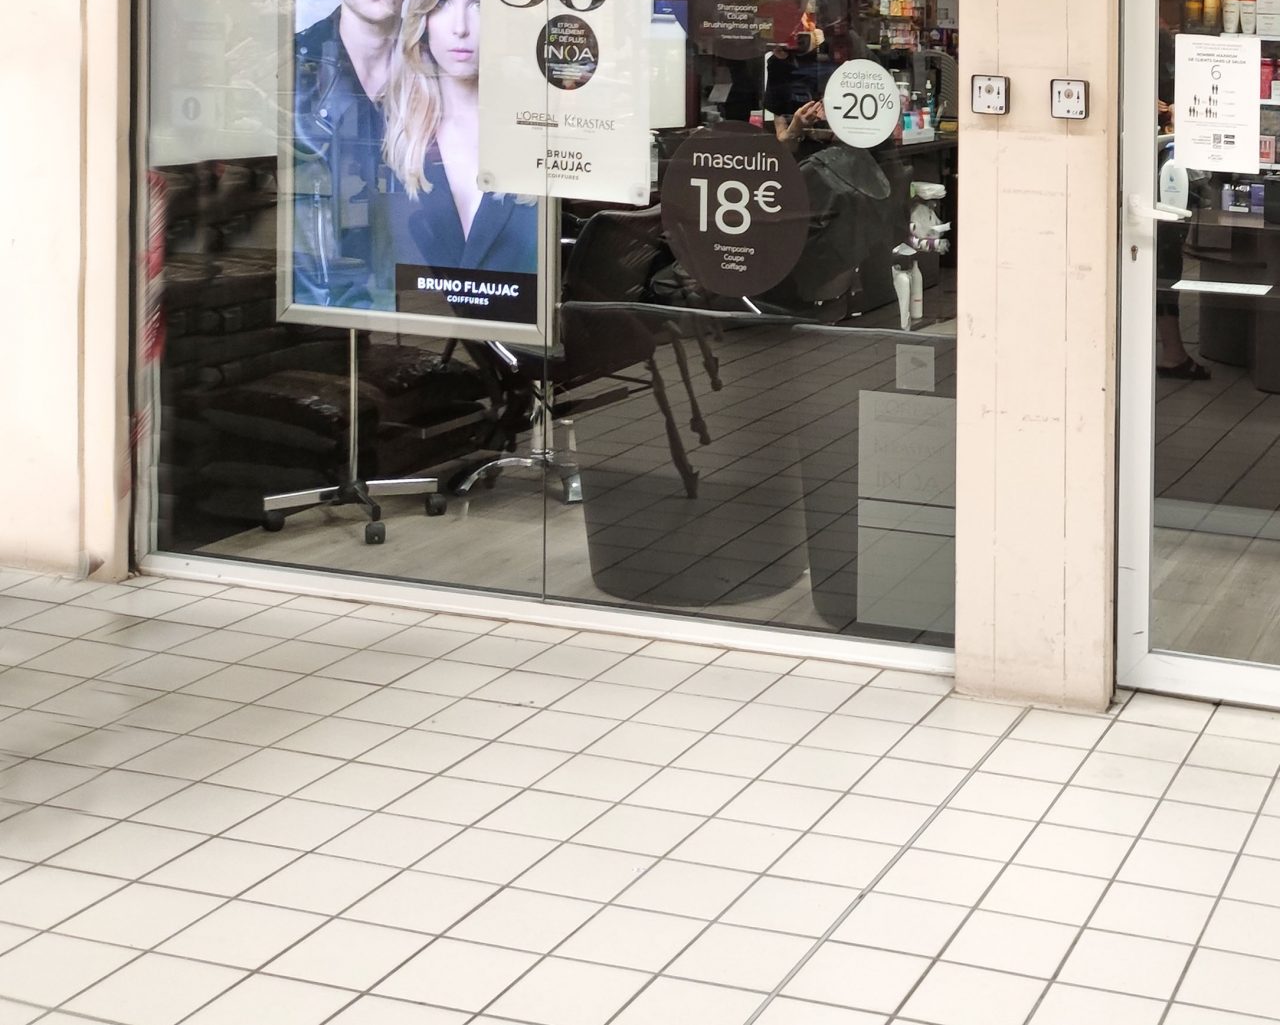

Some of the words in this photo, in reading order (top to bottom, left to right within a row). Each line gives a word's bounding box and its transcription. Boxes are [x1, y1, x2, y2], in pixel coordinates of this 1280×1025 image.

[717, 4, 758, 13] Shampooing
[727, 12, 748, 20] Coupe
[843, 71, 883, 81] scolaires
[1211, 64, 1222, 80] 6
[833, 93, 894, 120] -20%
[547, 150, 582, 160] BRUNO
[536, 158, 592, 173] FLAUJAC
[692, 151, 779, 172] masculin
[690, 177, 782, 235] 18€
[714, 244, 755, 255] Shampooing
[724, 254, 744, 262] Coupe
[721, 263, 747, 272] Coiffage
[417, 277, 462, 292] BRUNO
[464, 281, 519, 297] FLAUJAC
[447, 294, 489, 305] COIFFURES
